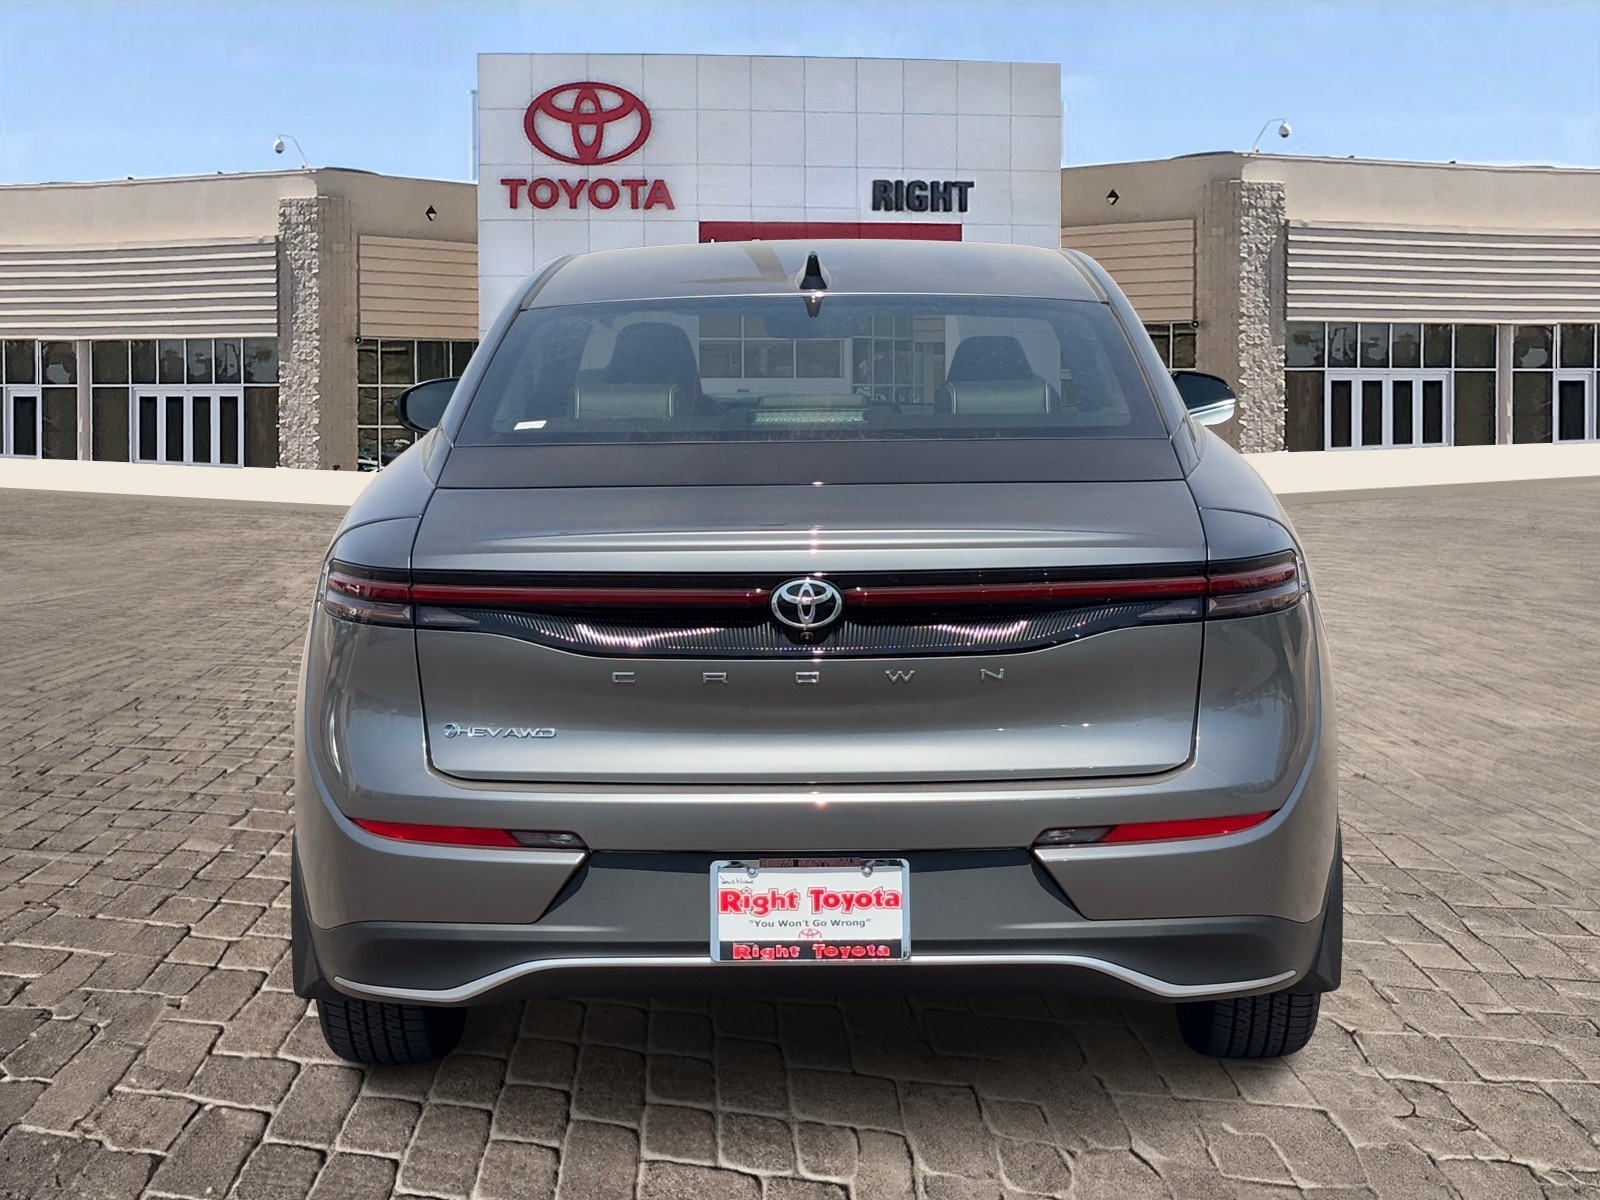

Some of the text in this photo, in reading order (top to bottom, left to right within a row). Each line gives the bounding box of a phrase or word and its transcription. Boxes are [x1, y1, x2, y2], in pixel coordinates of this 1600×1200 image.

[501, 178, 675, 210] TOYOTA
[871, 180, 974, 213] RIGHT
[612, 668, 1005, 684] CROWN
[719, 887, 902, 916] Right Toyota
[749, 919, 871, 928] "You Won't Go Wrong"
[733, 943, 890, 960] Right Toyota
